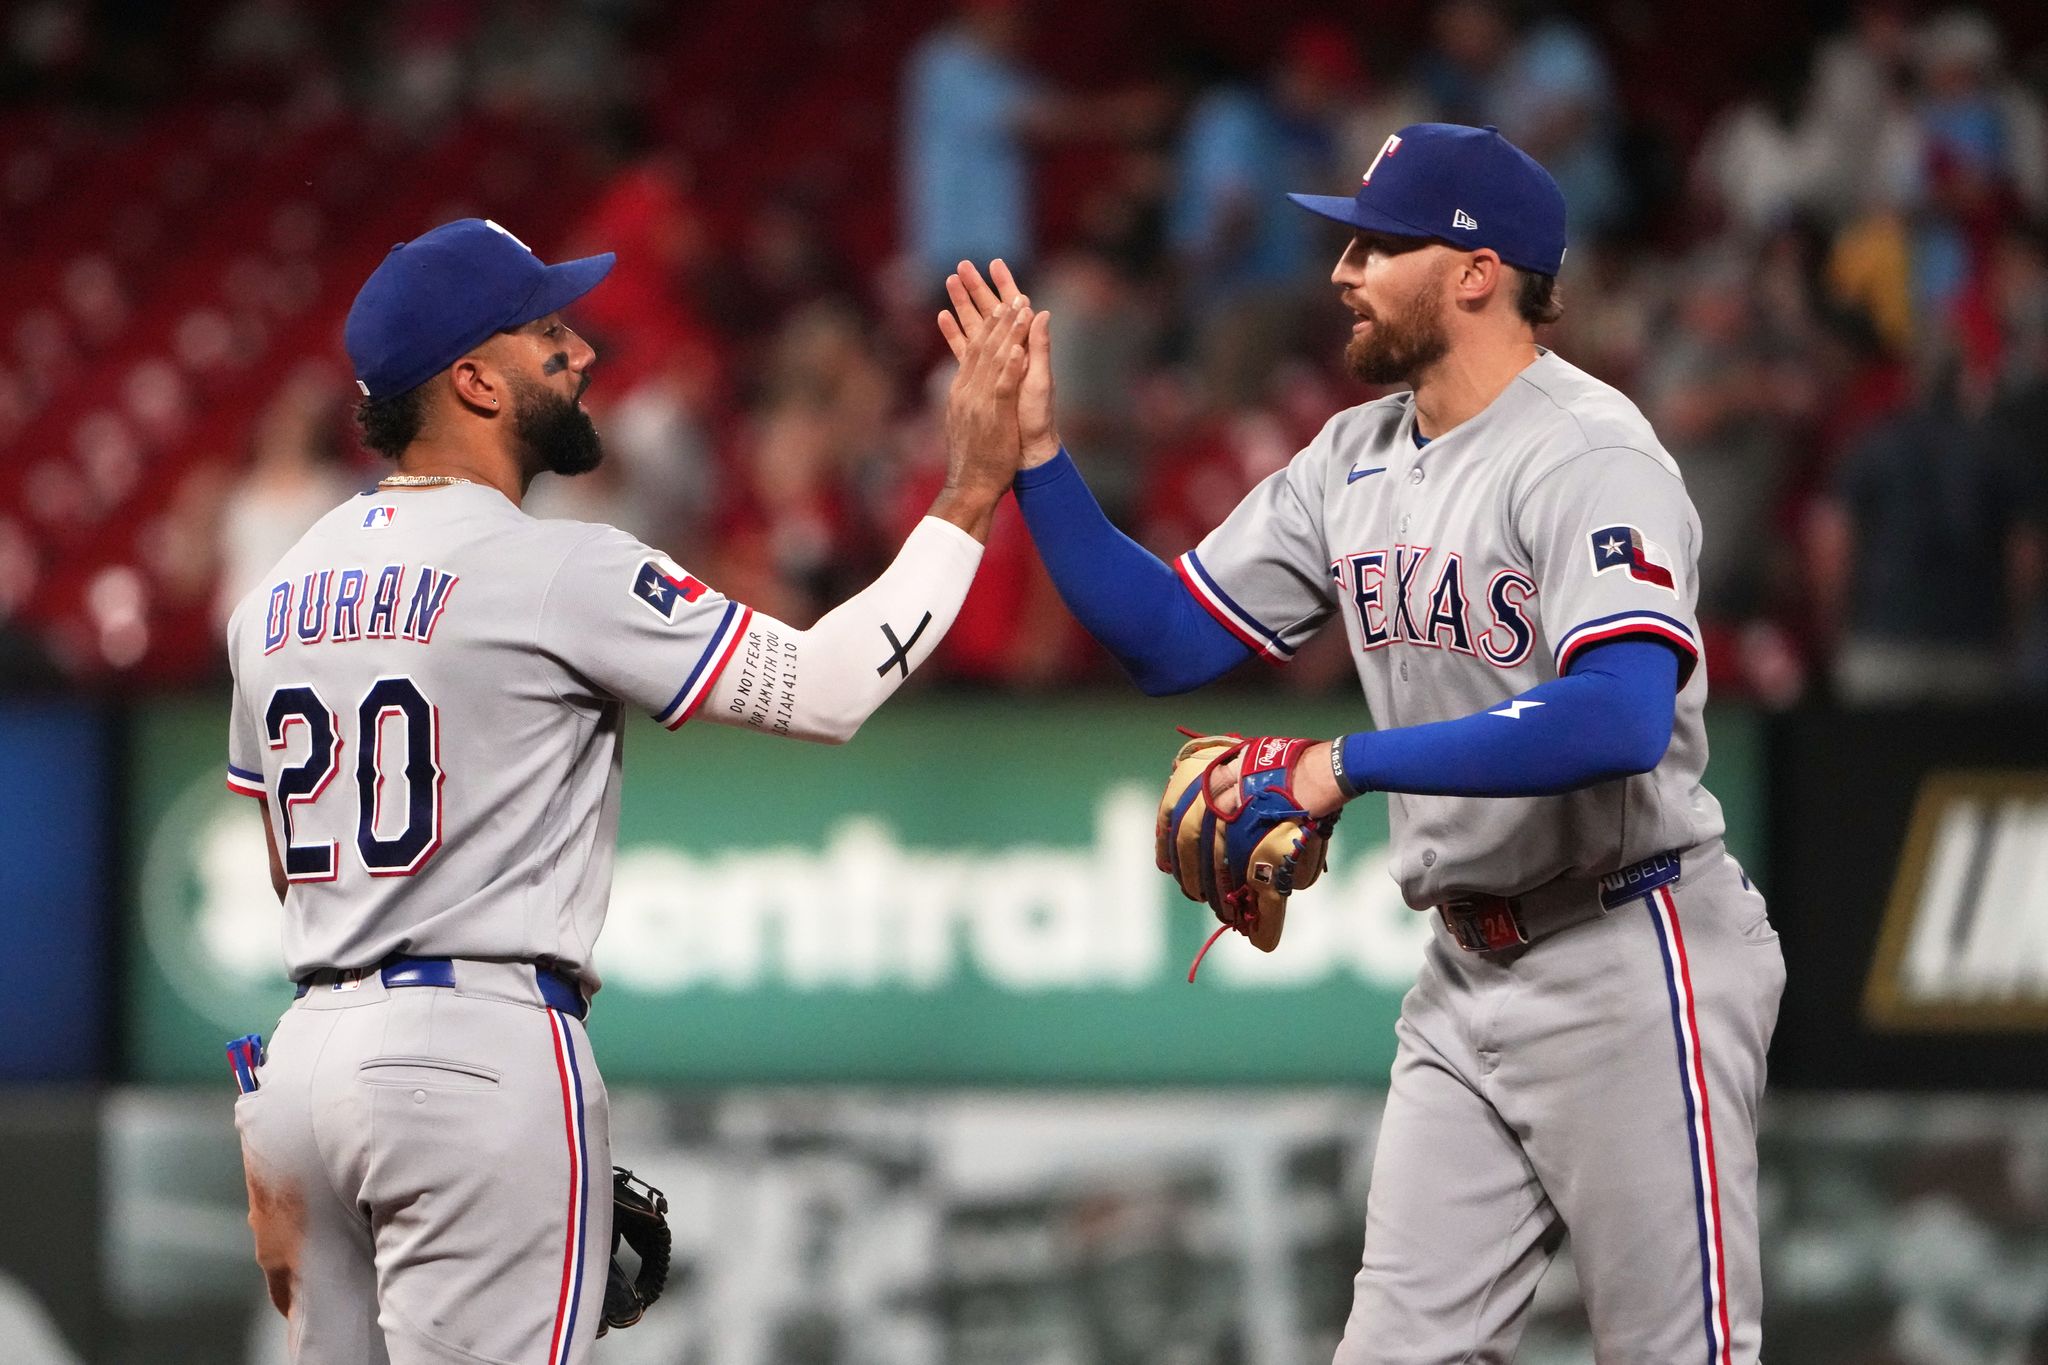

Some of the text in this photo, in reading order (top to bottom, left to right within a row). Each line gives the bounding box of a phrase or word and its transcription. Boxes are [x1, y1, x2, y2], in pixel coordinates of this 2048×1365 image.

[264, 562, 460, 656] DURAN
[766, 630, 779, 654] YOU
[729, 631, 762, 714] DO NOT FEAR
[782, 642, 797, 689] 41:10
[265, 673, 446, 884] 20
[598, 786, 1164, 988] entral
